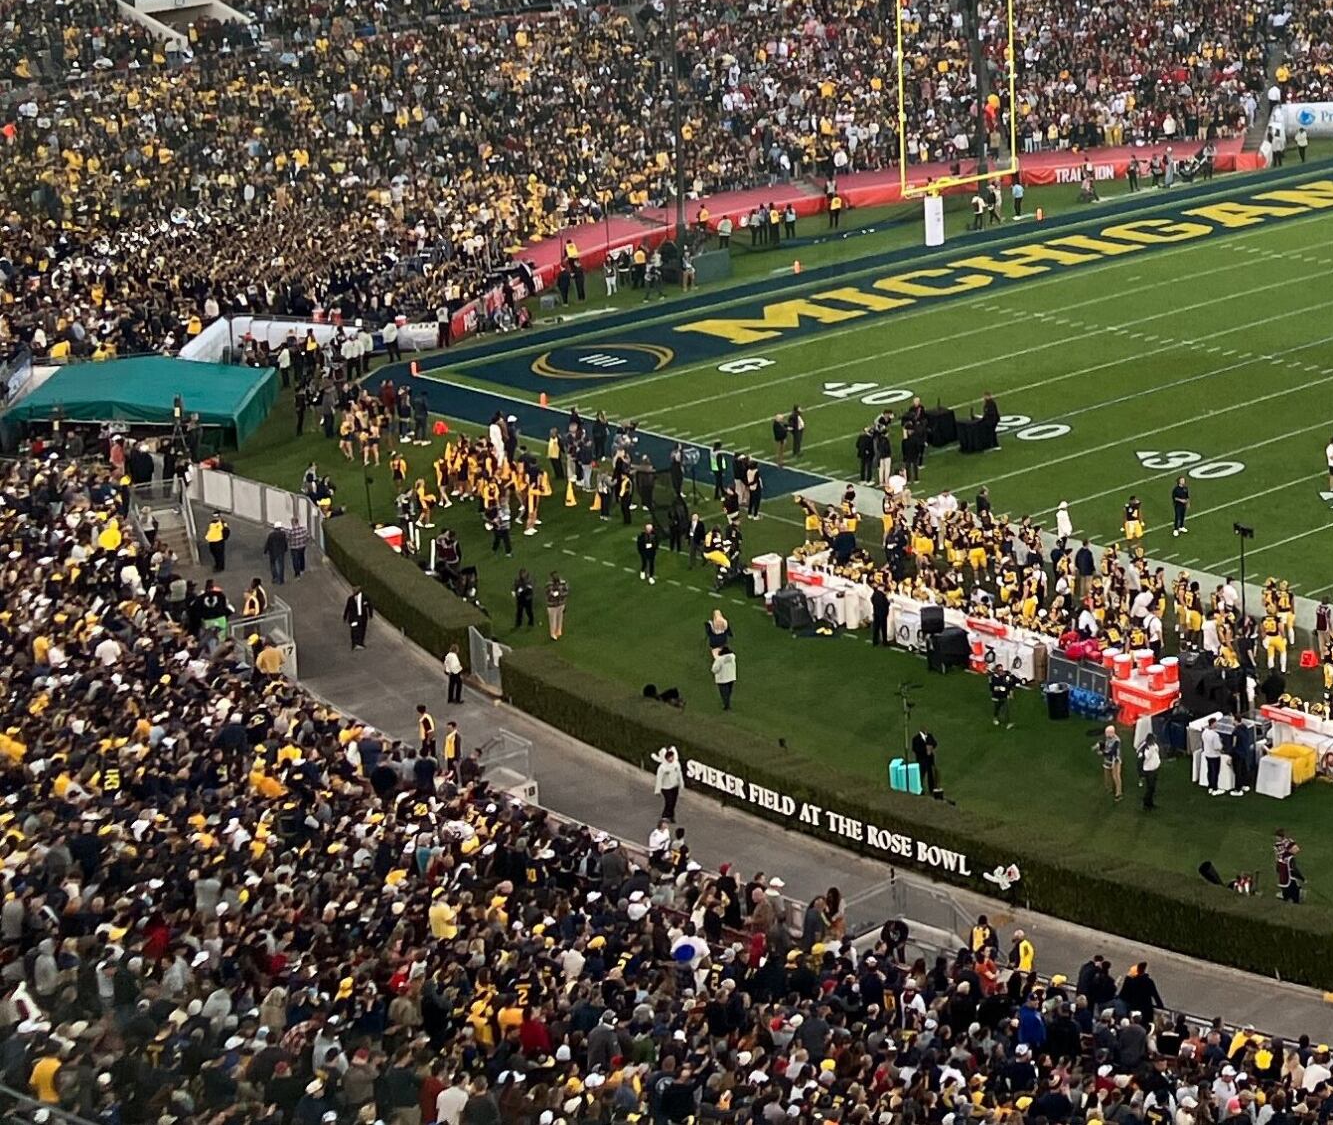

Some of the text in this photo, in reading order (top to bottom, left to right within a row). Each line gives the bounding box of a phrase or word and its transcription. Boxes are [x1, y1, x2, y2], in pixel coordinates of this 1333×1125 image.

[1055, 165, 1115, 183] TRAION
[717, 357, 776, 374] G
[822, 382, 914, 405] 10
[1141, 451, 1245, 479] 30
[686, 759, 971, 876] SPIEKER FIELD AT THE ROSE BOWL
